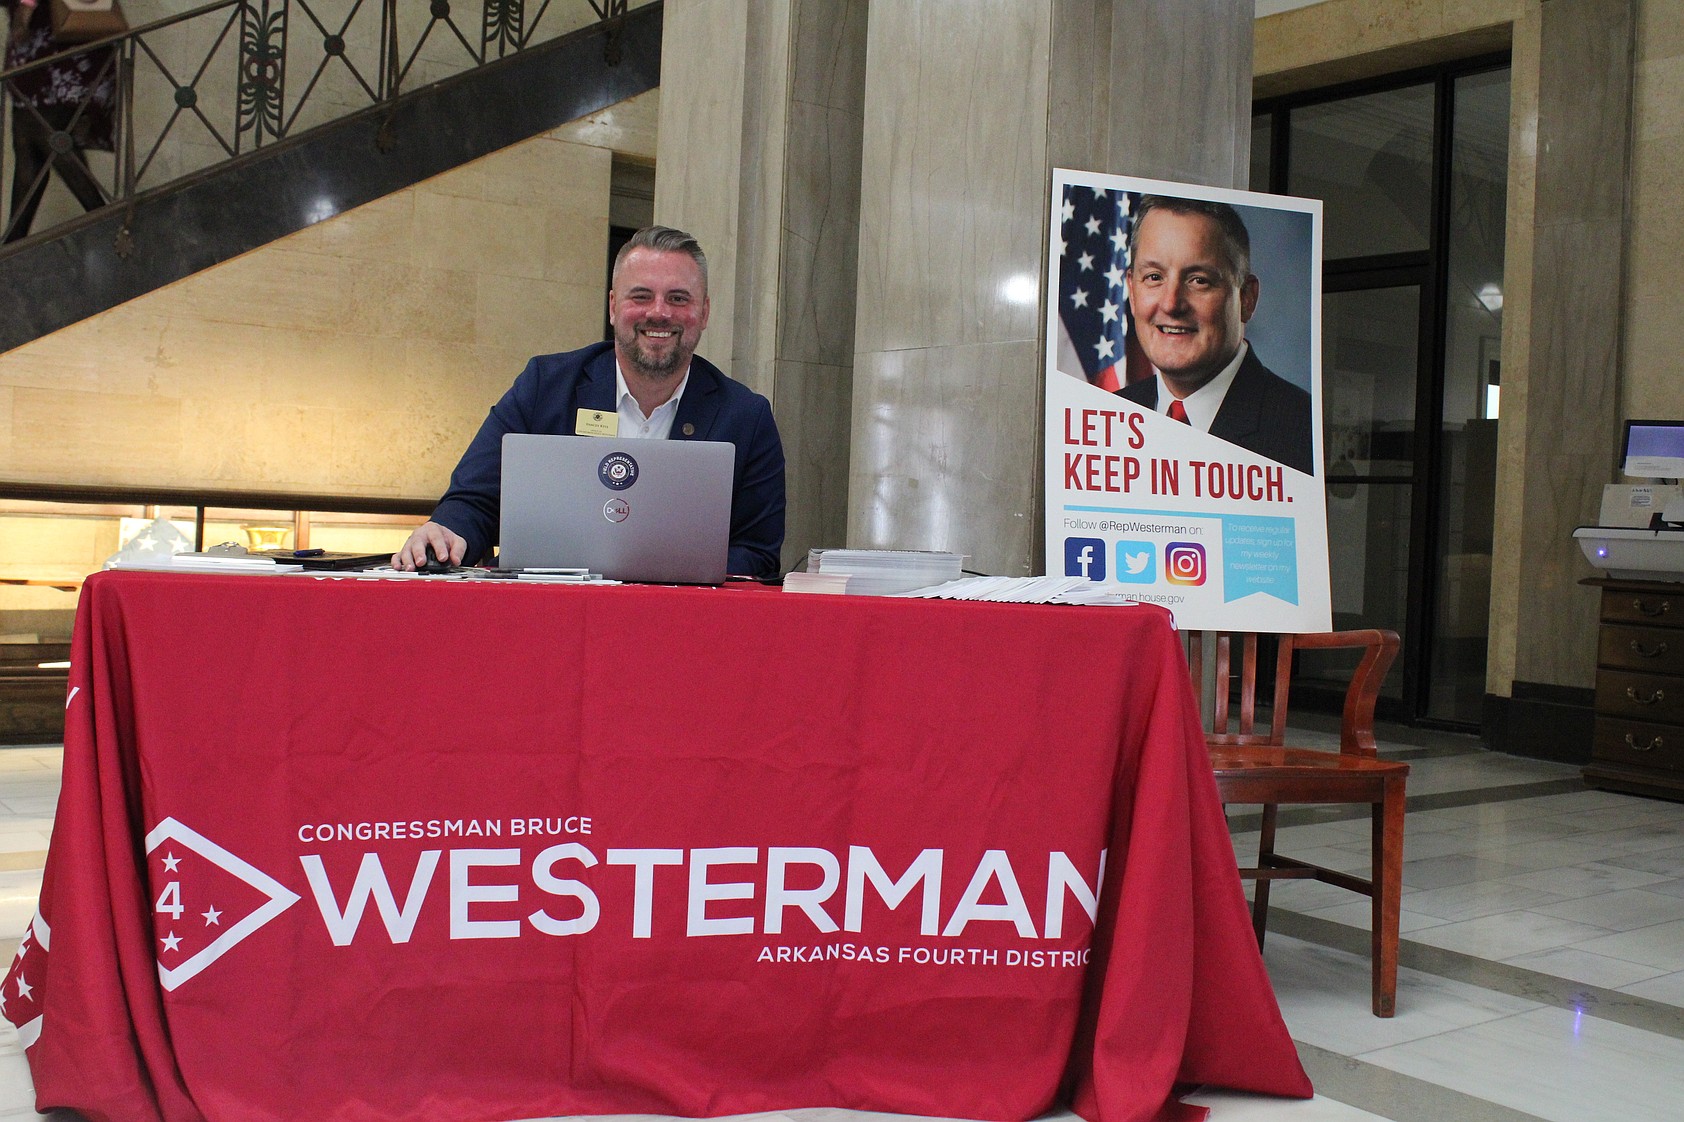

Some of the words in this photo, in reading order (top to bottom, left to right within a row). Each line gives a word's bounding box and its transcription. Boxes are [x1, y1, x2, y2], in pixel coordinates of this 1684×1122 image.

[1064, 408, 1145, 449] LET'S
[1064, 453, 1141, 493] KEEP
[1150, 458, 1179, 496] IN
[1189, 461, 1293, 502] TOUCH.
[1063, 518, 1097, 530] Follow
[1099, 520, 1187, 535] @RepWesterman
[1228, 523, 1238, 532] To
[1238, 524, 1265, 533] receive
[1266, 526, 1290, 535] regular
[1241, 550, 1252, 560] my
[1253, 551, 1279, 560] weekly
[1257, 538, 1272, 547] sign
[1273, 539, 1283, 548] up
[1284, 539, 1293, 547] for
[1230, 562, 1266, 571] newsletter
[1279, 565, 1290, 574] my
[298, 819, 501, 843] CONGRESSMAN
[510, 816, 592, 836] BRUCE
[155, 881, 185, 920] 4
[299, 842, 1107, 946] WESTERMAN
[757, 943, 890, 963] ARKANSAS
[898, 947, 998, 966] FOURTH
[1006, 948, 1091, 968] DISTRIC
